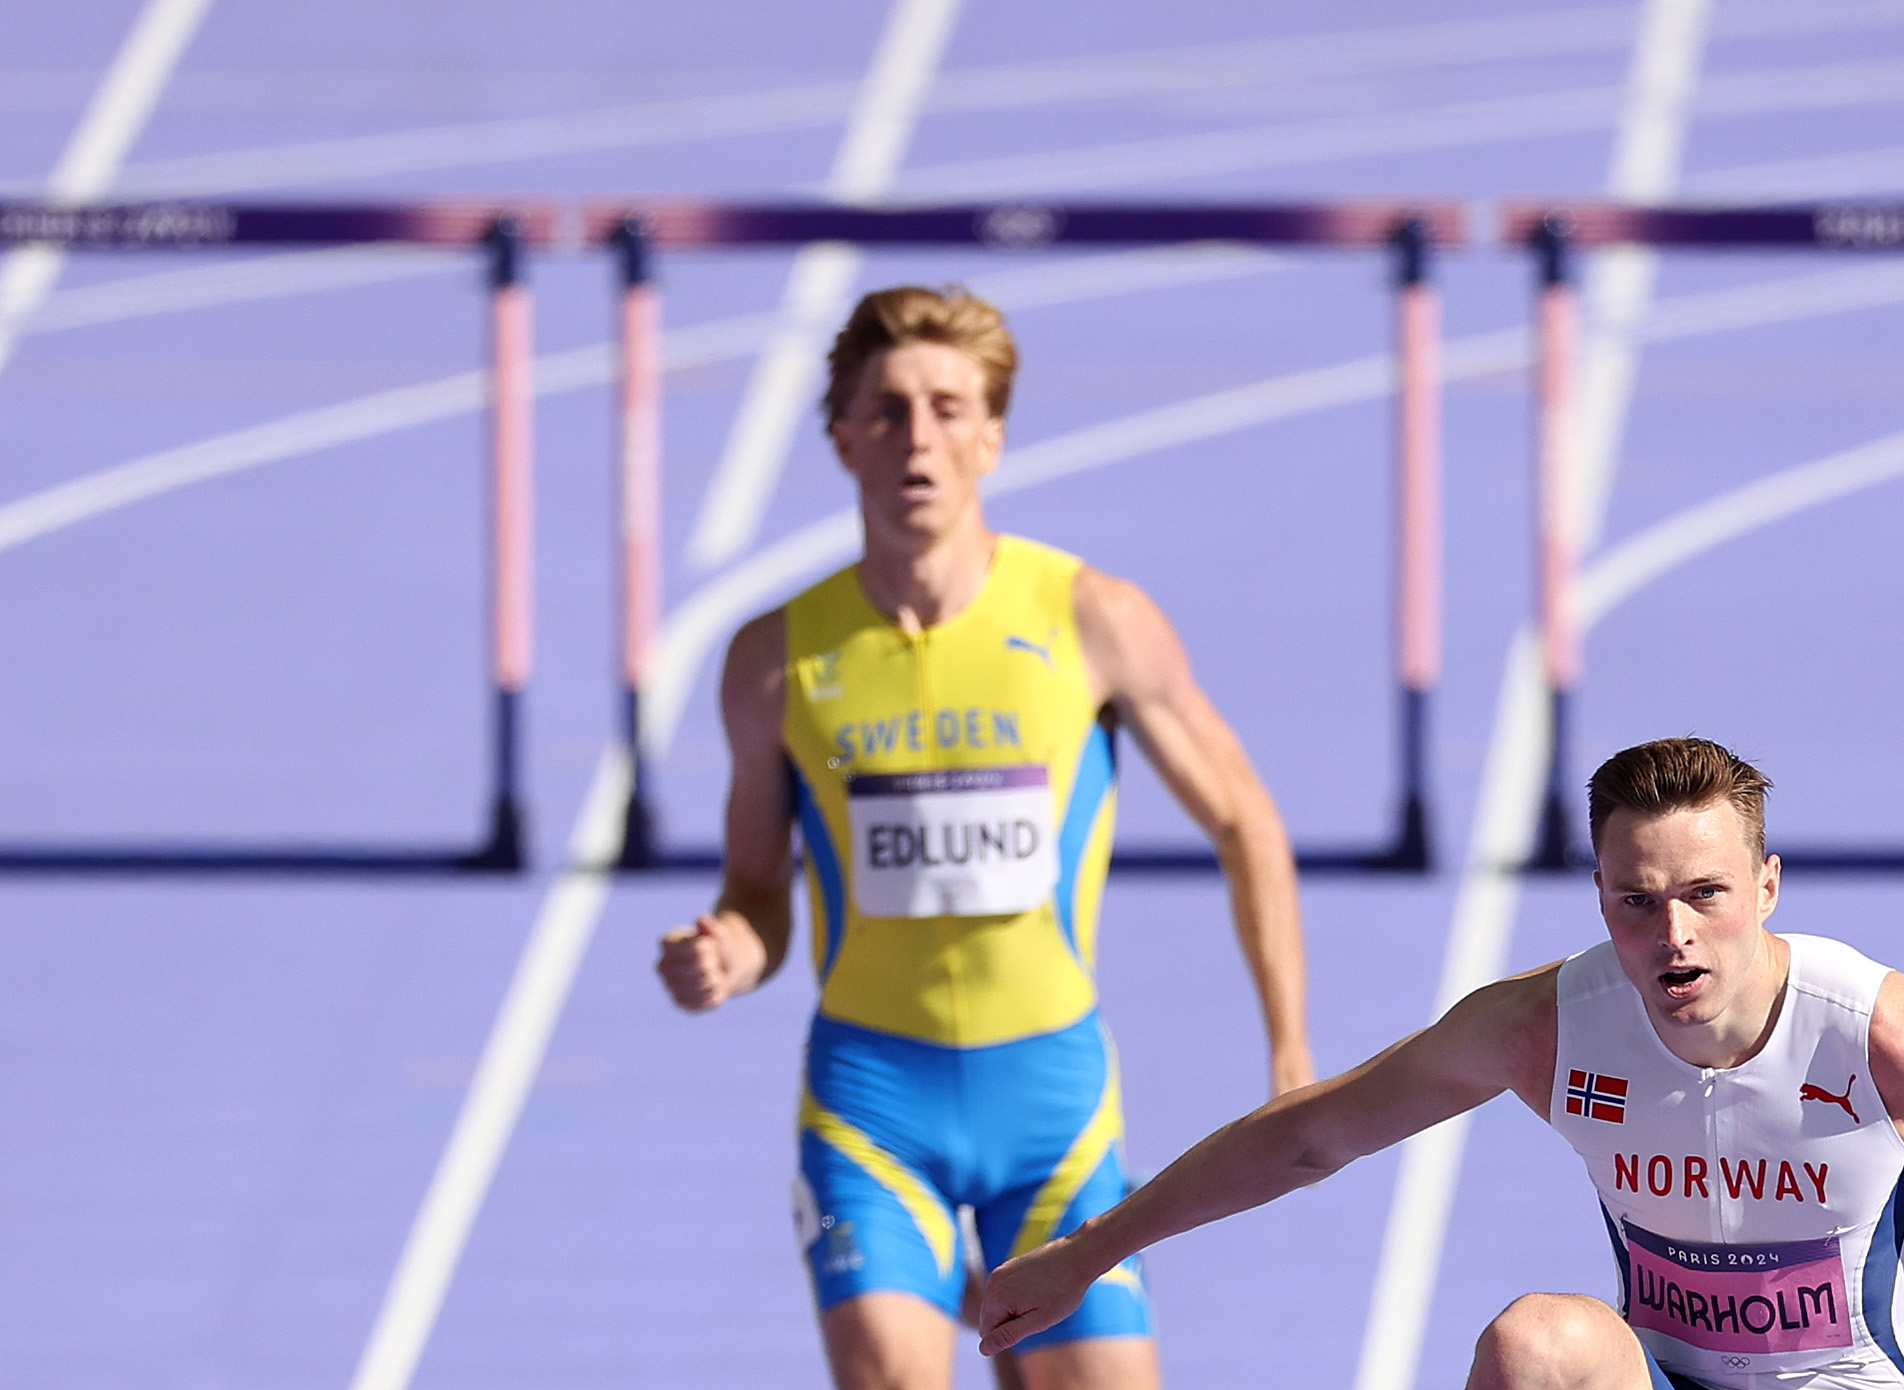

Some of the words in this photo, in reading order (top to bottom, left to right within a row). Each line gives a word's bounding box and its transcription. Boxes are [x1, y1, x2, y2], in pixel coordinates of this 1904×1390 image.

[834, 707, 1021, 768] SWEDEN
[867, 818, 1039, 870] EDLUND
[1613, 1153, 1829, 1204] NORWAY
[1667, 1245, 1720, 1266] PARIS
[1727, 1252, 1779, 1266] 2024
[1636, 1264, 1838, 1335] WARHOLM
